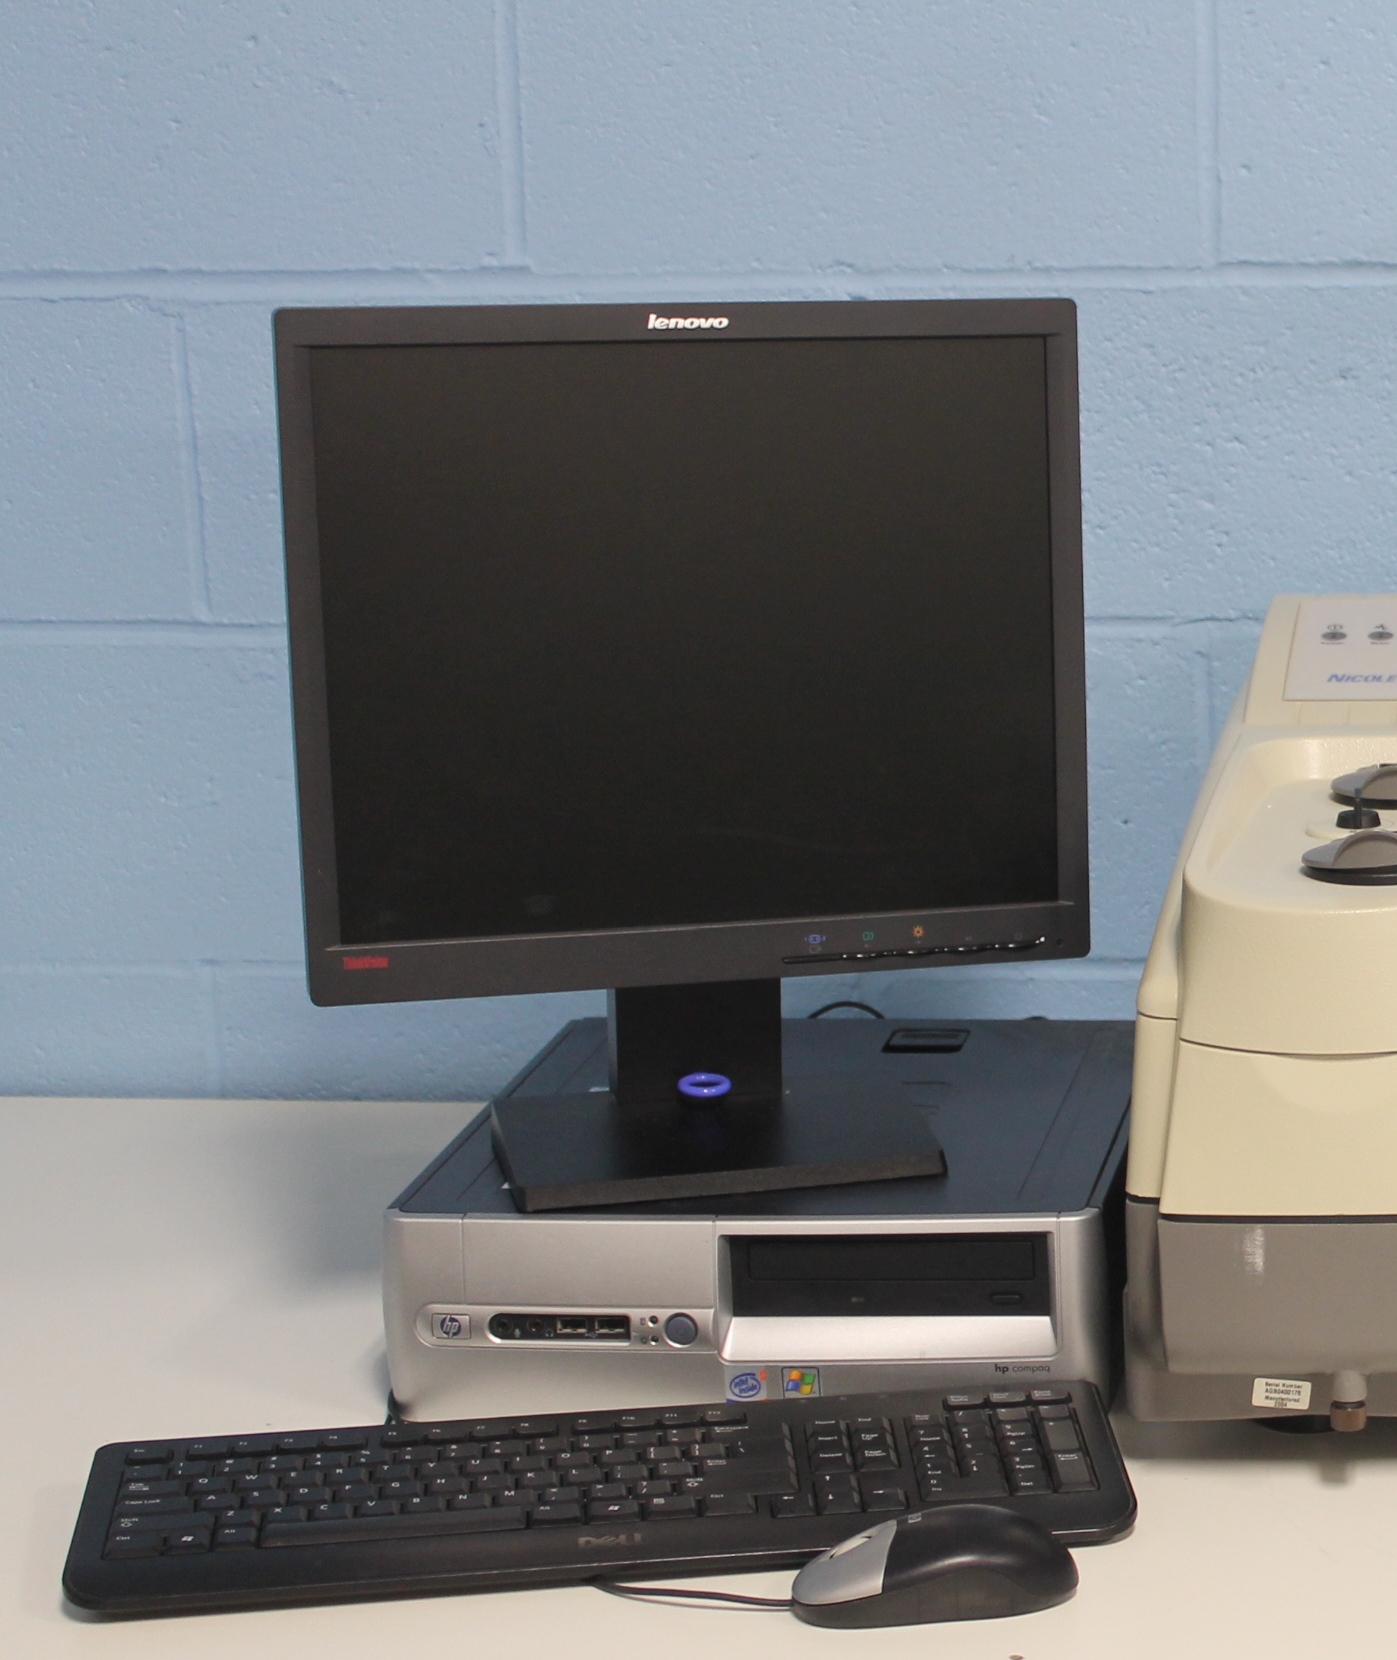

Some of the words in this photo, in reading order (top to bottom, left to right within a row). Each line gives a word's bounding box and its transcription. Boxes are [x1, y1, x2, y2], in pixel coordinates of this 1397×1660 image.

[647, 314, 729, 329] lenovo
[995, 1364, 1009, 1374] hp
[1012, 1365, 1050, 1373] compaq
